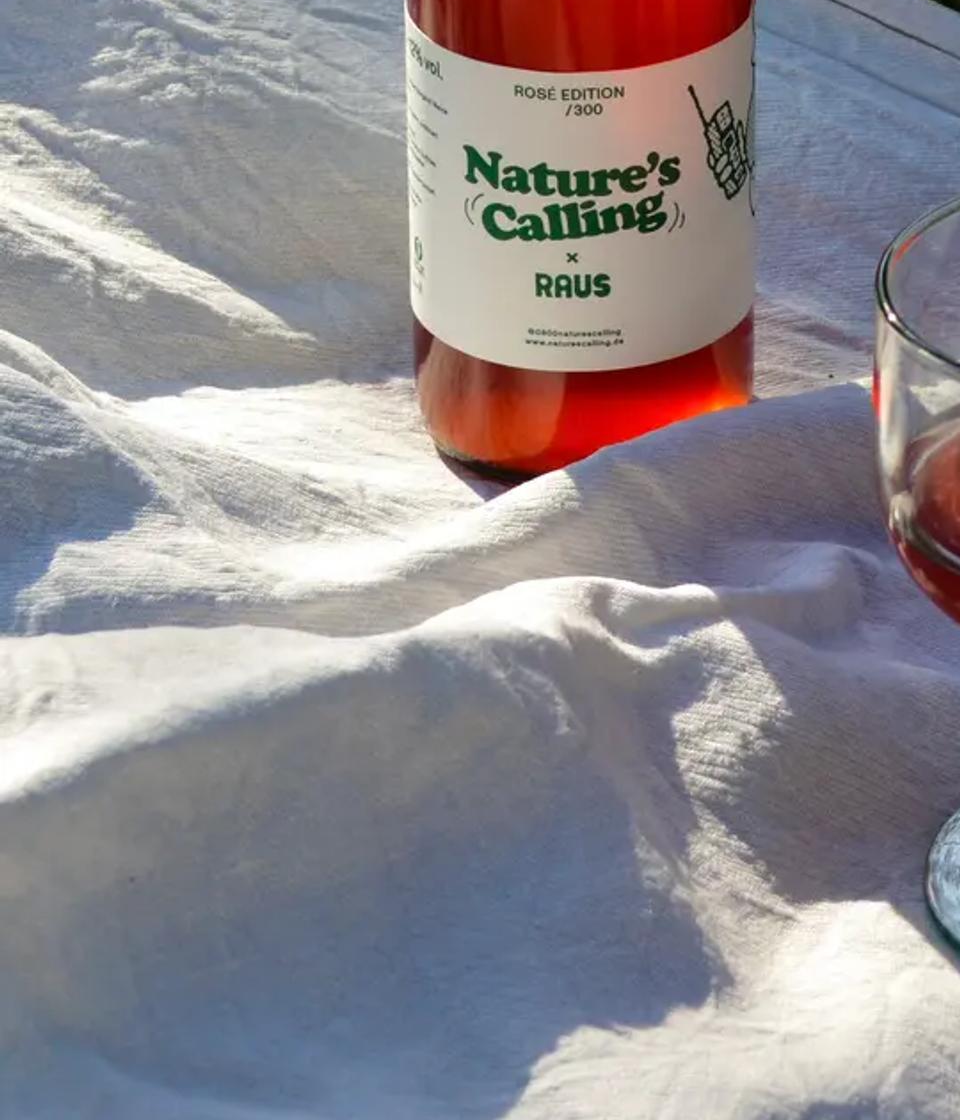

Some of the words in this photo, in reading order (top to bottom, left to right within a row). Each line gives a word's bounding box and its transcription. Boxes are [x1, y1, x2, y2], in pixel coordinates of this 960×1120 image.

[513, 84, 557, 101] ROSÉ
[561, 86, 625, 101] EDITION
[565, 103, 604, 117] /300
[462, 144, 681, 197] Nature's
[481, 190, 668, 242] Calling
[535, 273, 612, 299] RAUS
[525, 338, 624, 349] www.naturescalling.de
